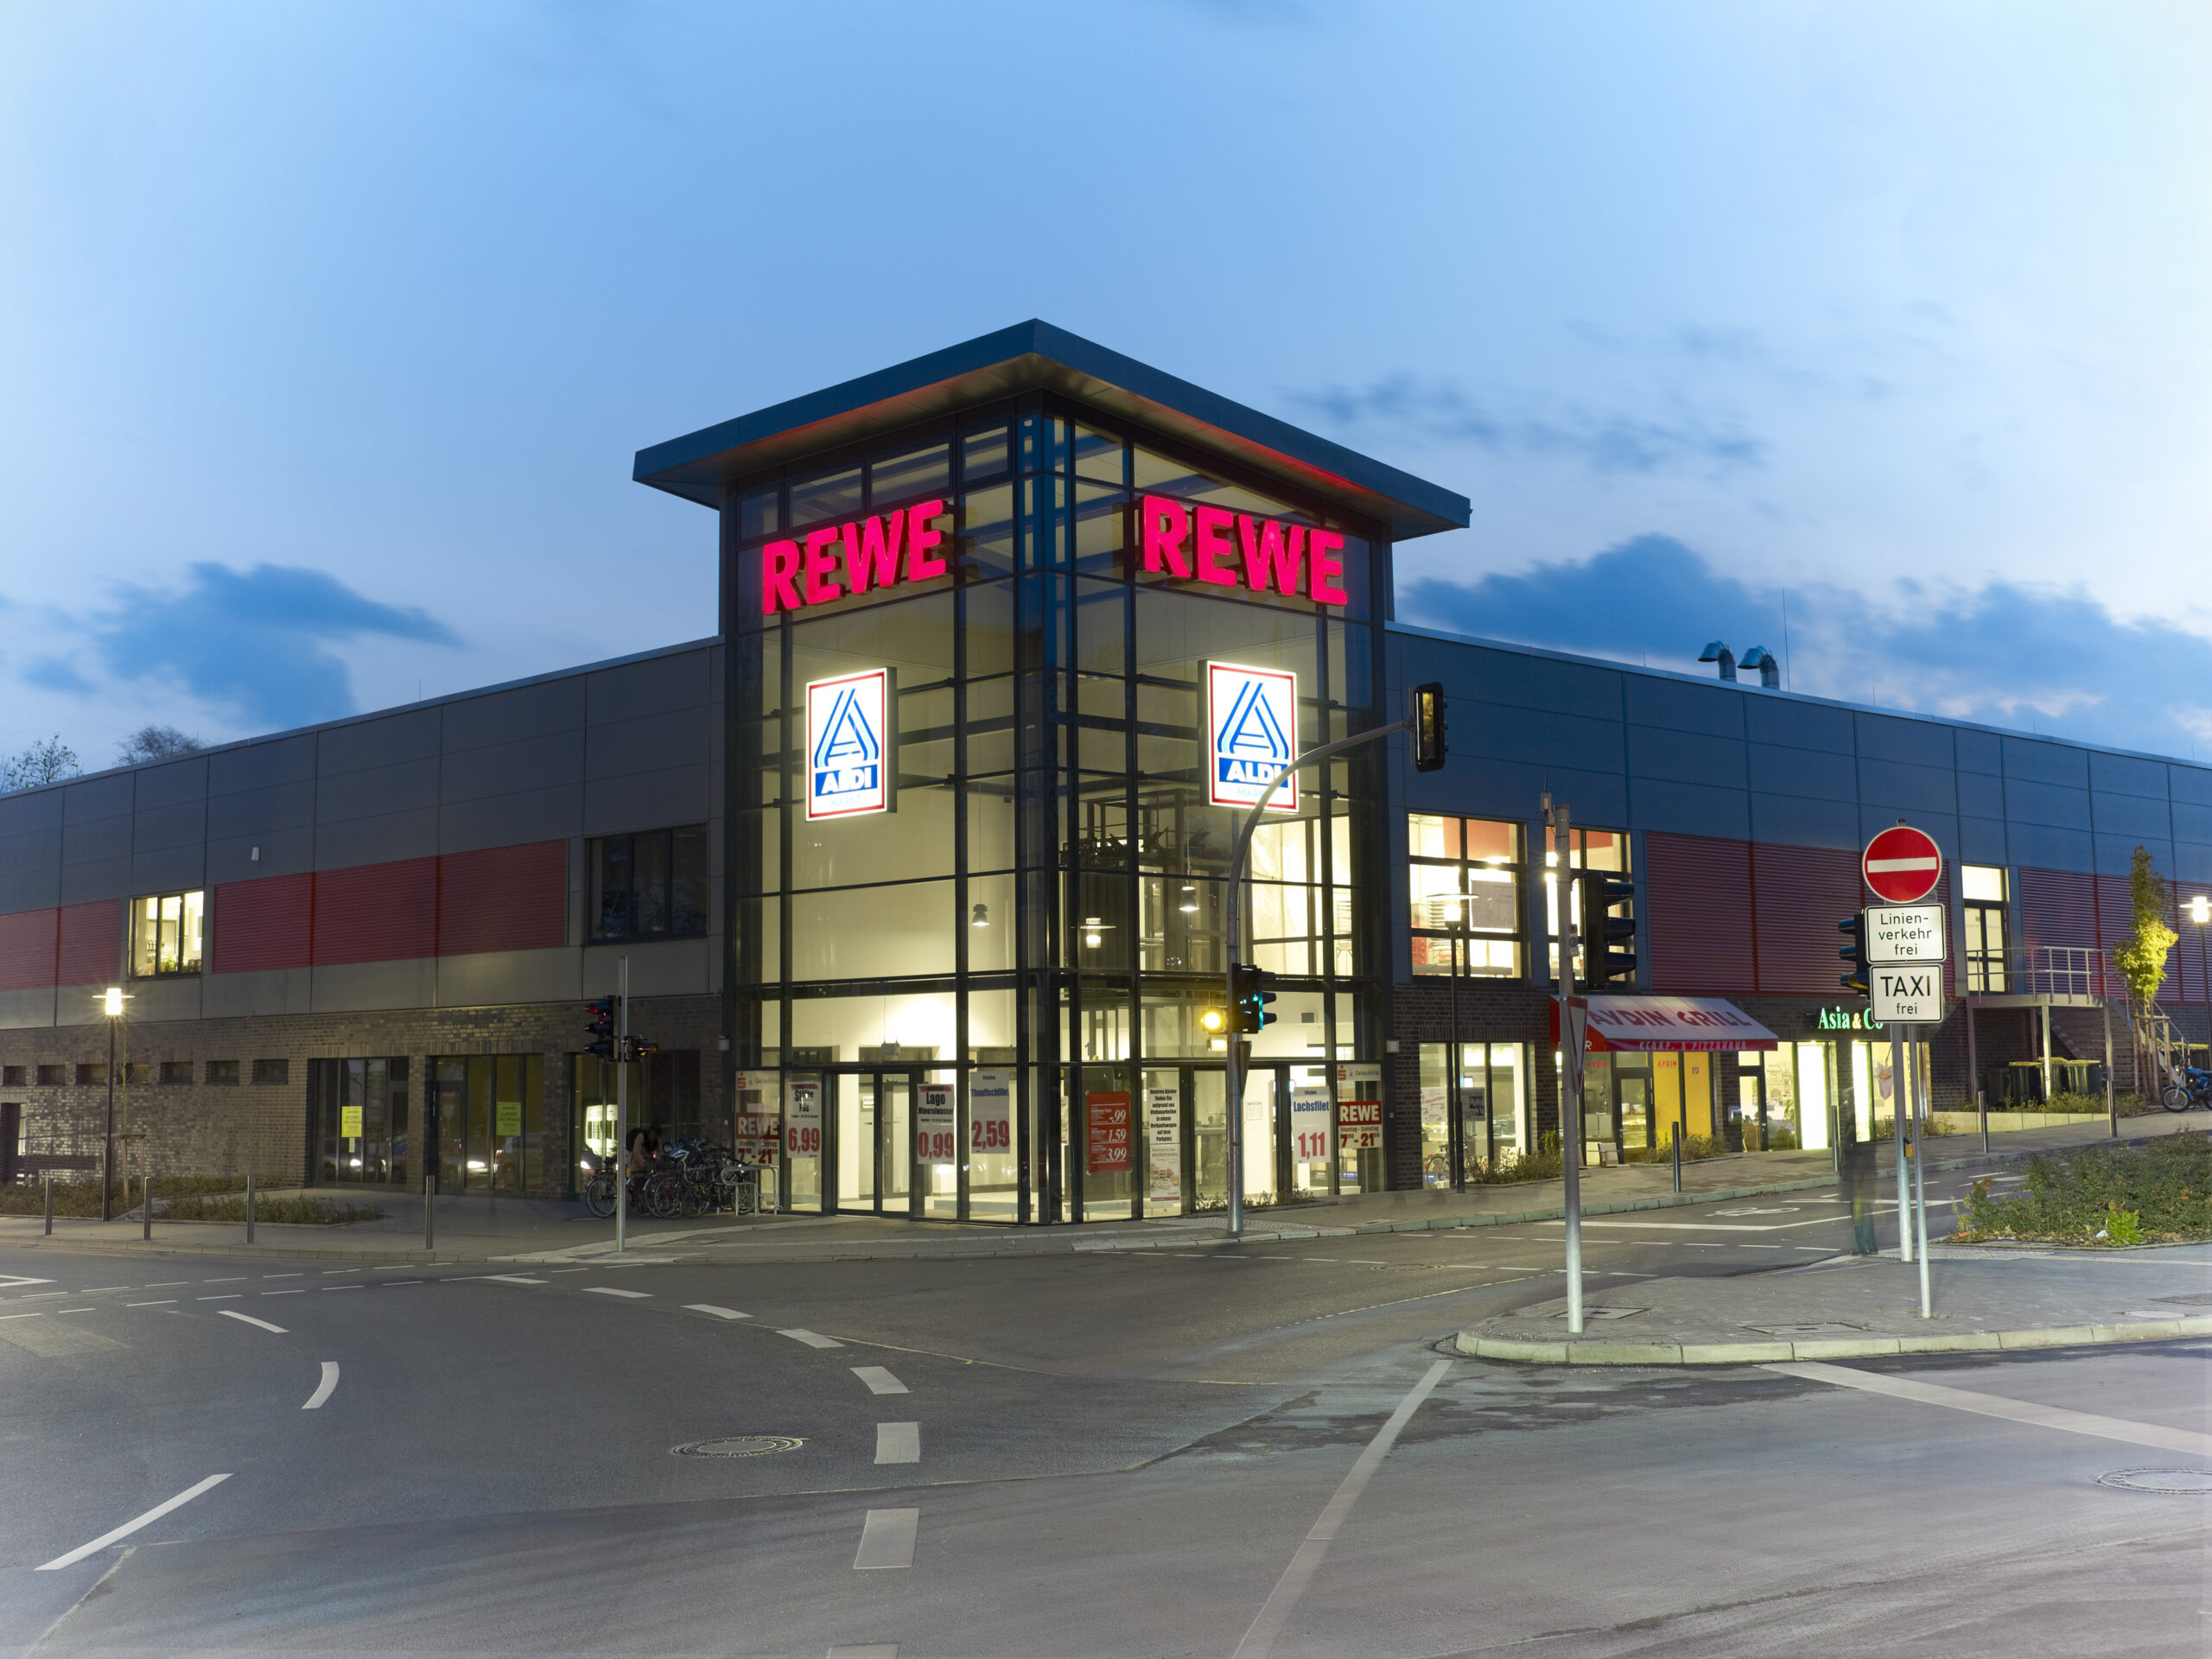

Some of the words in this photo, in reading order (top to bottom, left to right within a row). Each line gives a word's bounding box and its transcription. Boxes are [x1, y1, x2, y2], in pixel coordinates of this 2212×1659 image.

[763, 499, 946, 615] REWE
[1144, 495, 1347, 606] REWE
[821, 766, 872, 794] ALDI
[1880, 912, 1929, 925] Linien-
[1878, 927, 1932, 940] verkehr
[1894, 944, 1917, 956] frei
[1880, 976, 1930, 997] TAXI
[1897, 1002, 1917, 1014] frei
[1587, 1009, 1676, 1027] AYDIN
[1676, 1010, 1752, 1027] GRILL
[1818, 1006, 1850, 1030] Asia
[1852, 1013, 1861, 1030] &
[926, 1092, 945, 1106] Lago
[1294, 1101, 1329, 1112] Lachsfilet
[1340, 1104, 1379, 1122] REWE
[738, 1116, 779, 1135] REWE
[971, 1120, 1010, 1149] 2,59
[788, 1127, 820, 1154] 6,99
[1108, 1128, 1127, 1142] 1.59
[918, 1132, 955, 1160] 0,99
[1106, 1147, 1127, 1161] 3.99
[1298, 1132, 1325, 1160] 1,11
